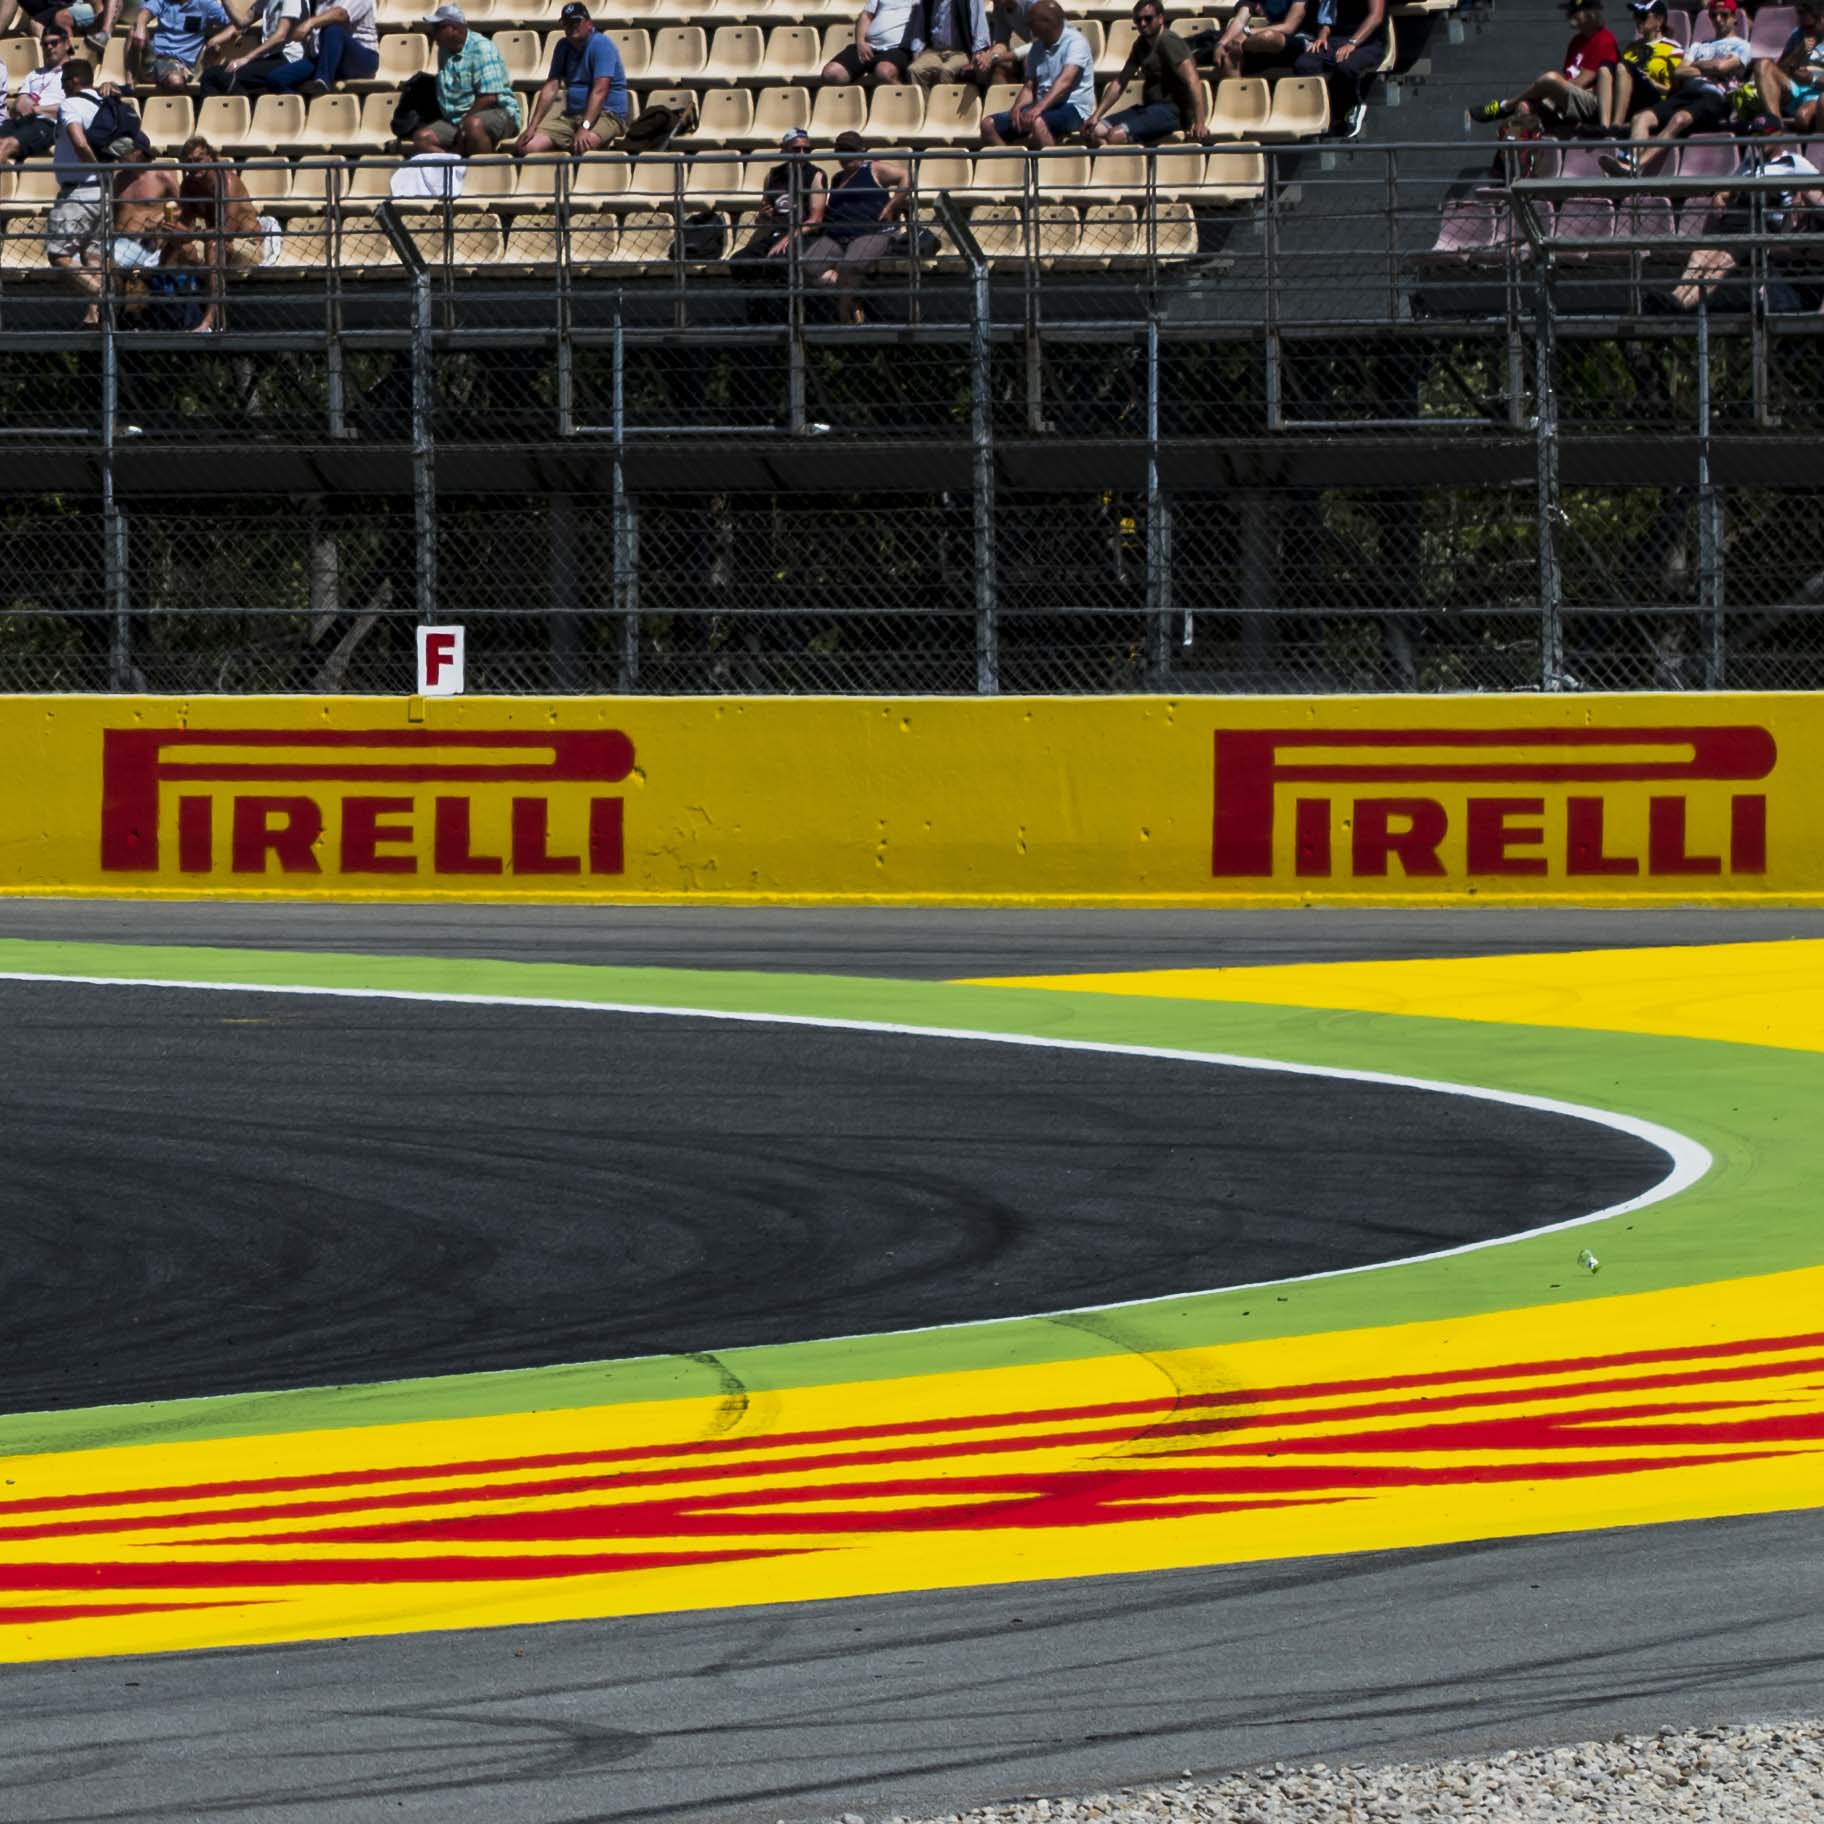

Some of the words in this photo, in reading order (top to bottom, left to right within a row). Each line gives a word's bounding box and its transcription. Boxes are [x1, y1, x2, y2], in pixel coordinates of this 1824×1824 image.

[425, 634, 455, 685] F
[102, 727, 635, 875] PIRELLI
[1213, 726, 1777, 876] PIRELLI
